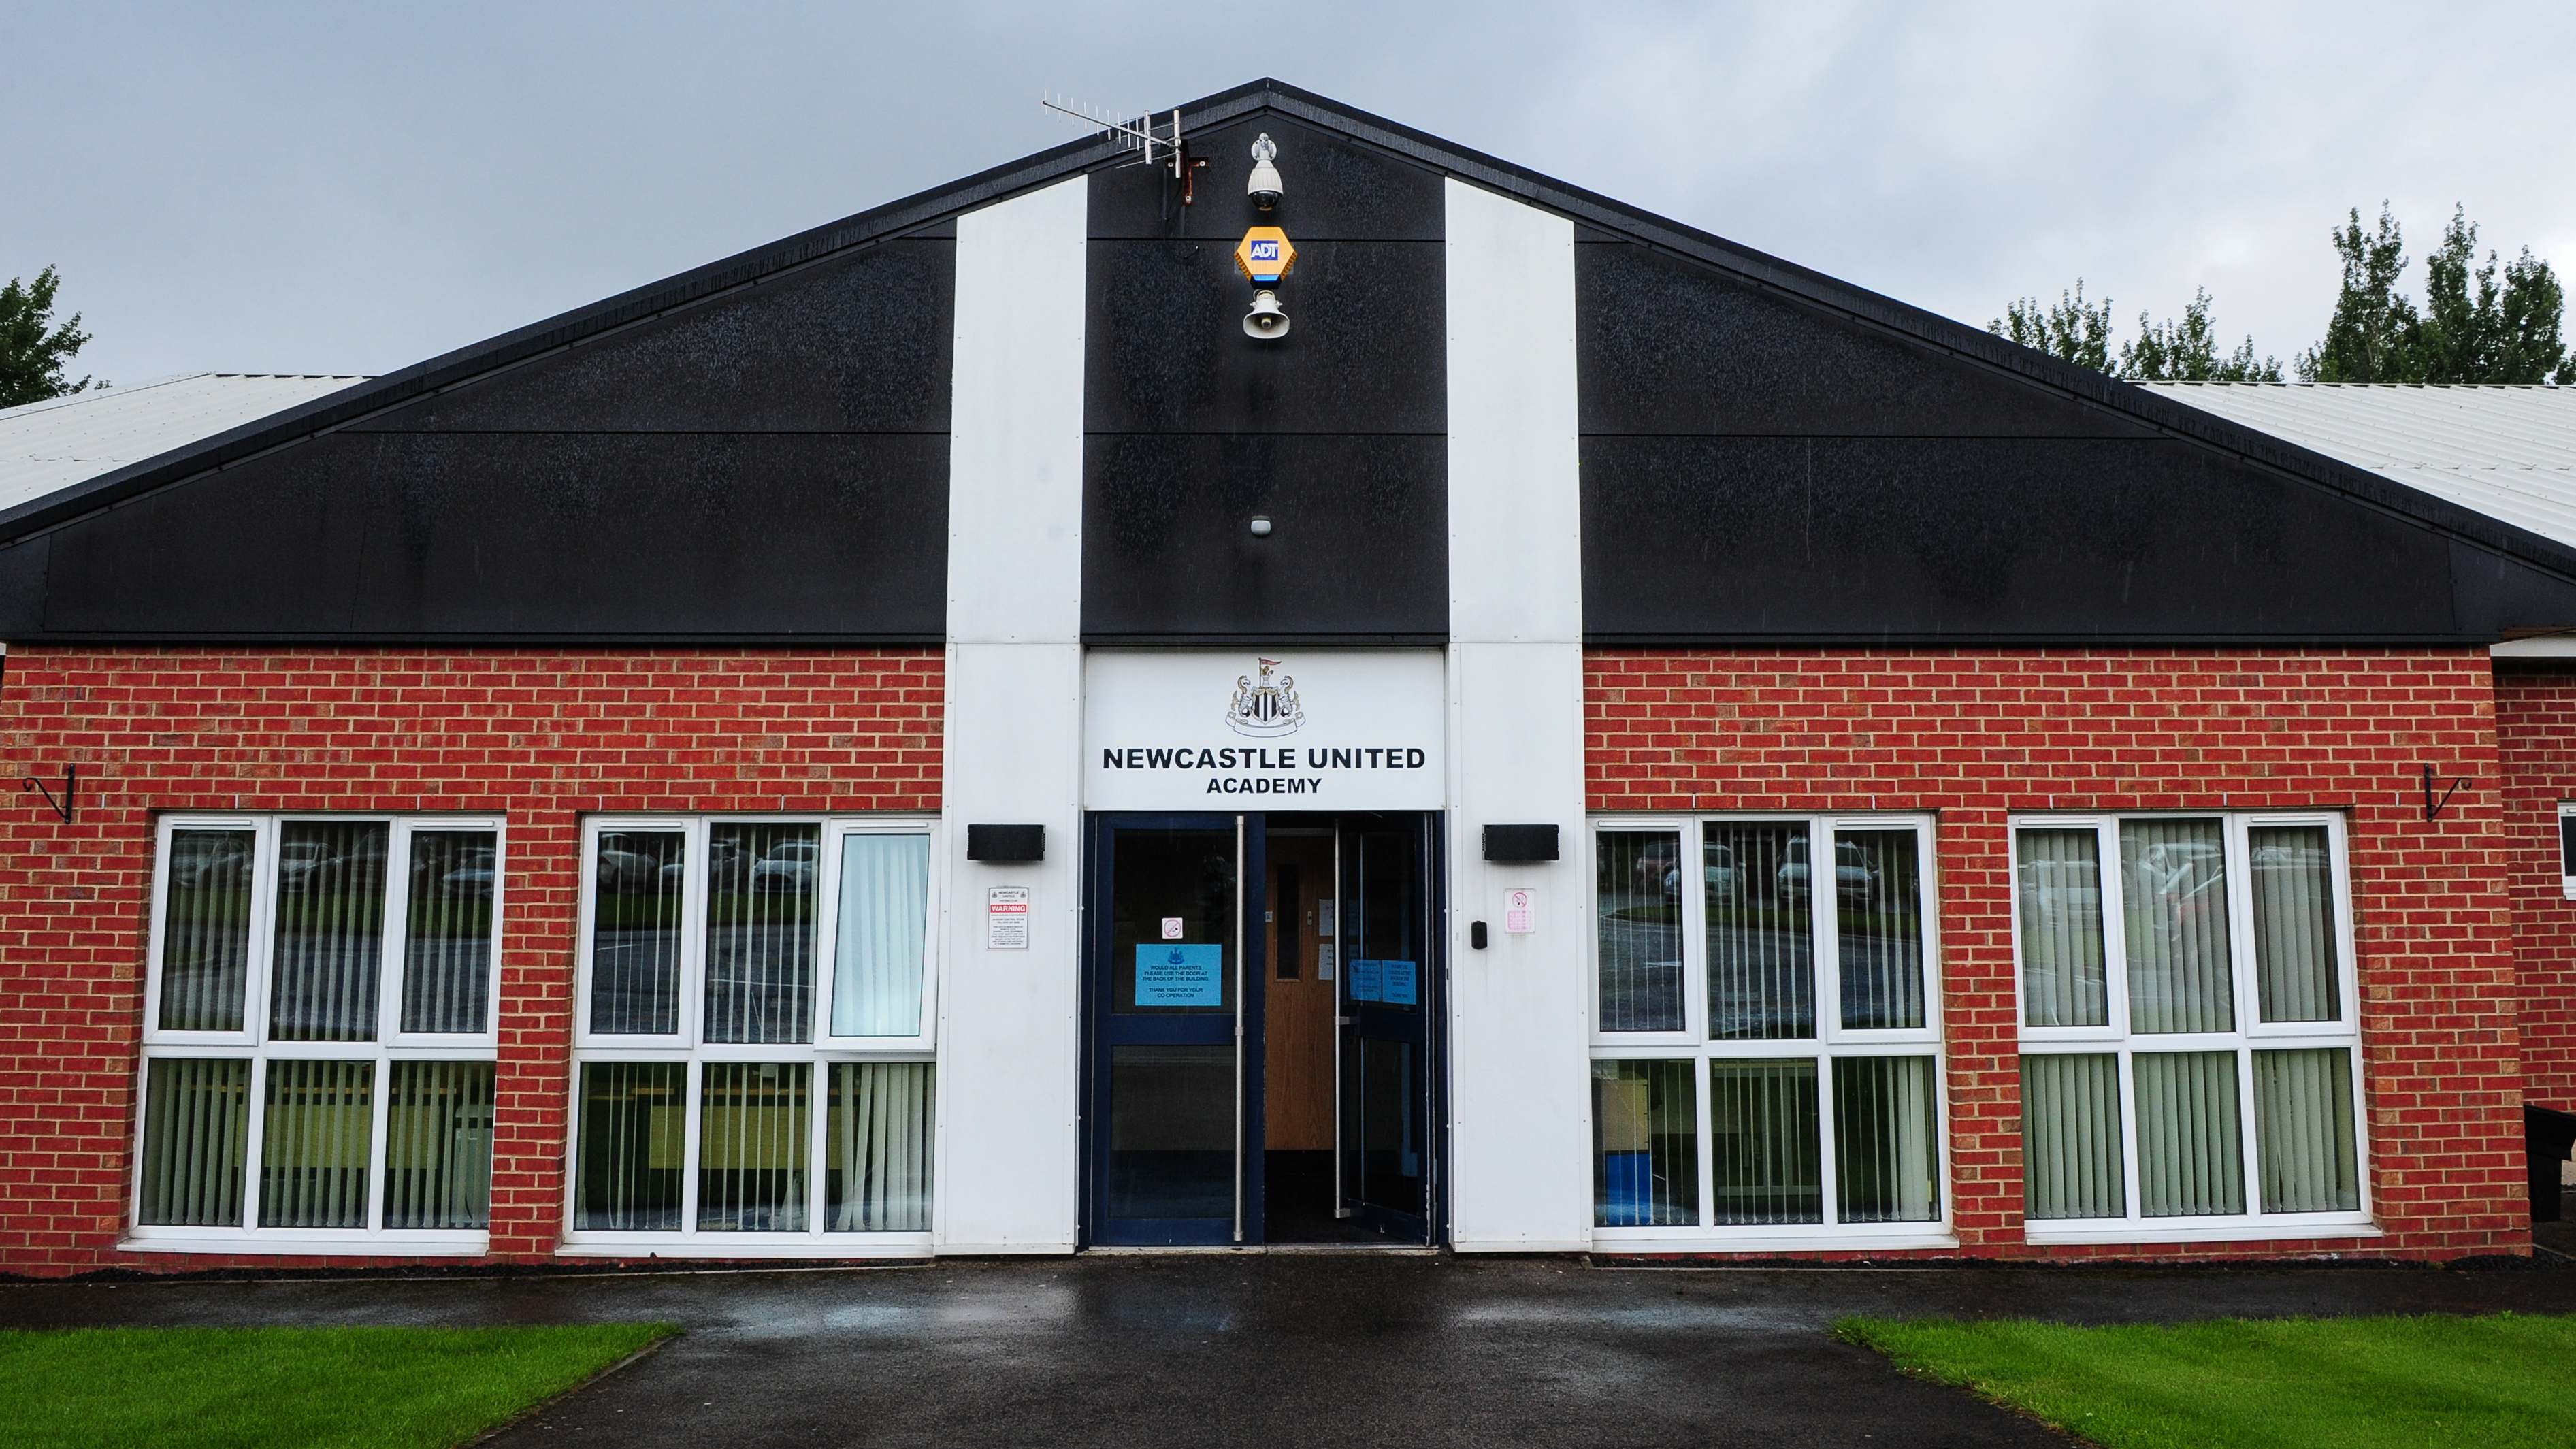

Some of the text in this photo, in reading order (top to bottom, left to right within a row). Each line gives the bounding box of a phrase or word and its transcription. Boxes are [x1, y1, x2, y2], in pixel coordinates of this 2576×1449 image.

[1251, 243, 1279, 257] ADT
[1103, 748, 1426, 770] NEWCASTLE UNITED
[1206, 778, 1322, 794] ACADEMY
